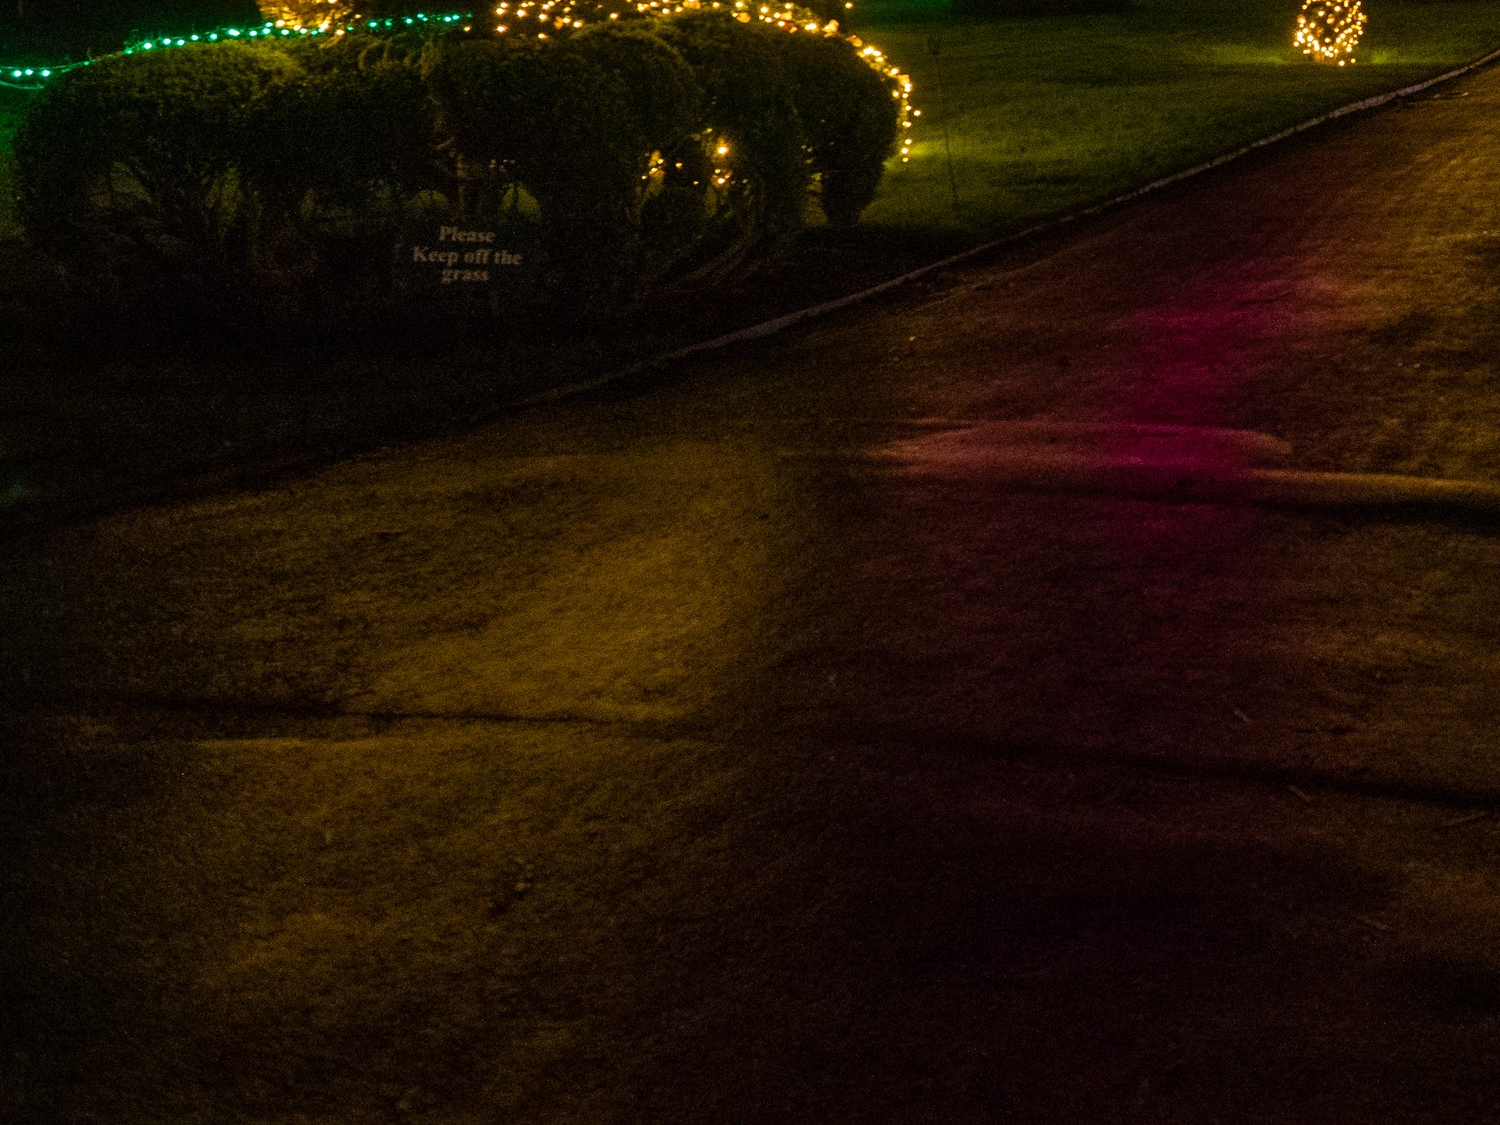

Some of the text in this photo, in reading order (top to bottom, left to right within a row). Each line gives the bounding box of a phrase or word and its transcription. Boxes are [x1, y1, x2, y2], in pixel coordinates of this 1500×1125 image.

[439, 225, 496, 243] Please
[411, 245, 523, 267] Keep off the
[440, 268, 491, 284] grass
